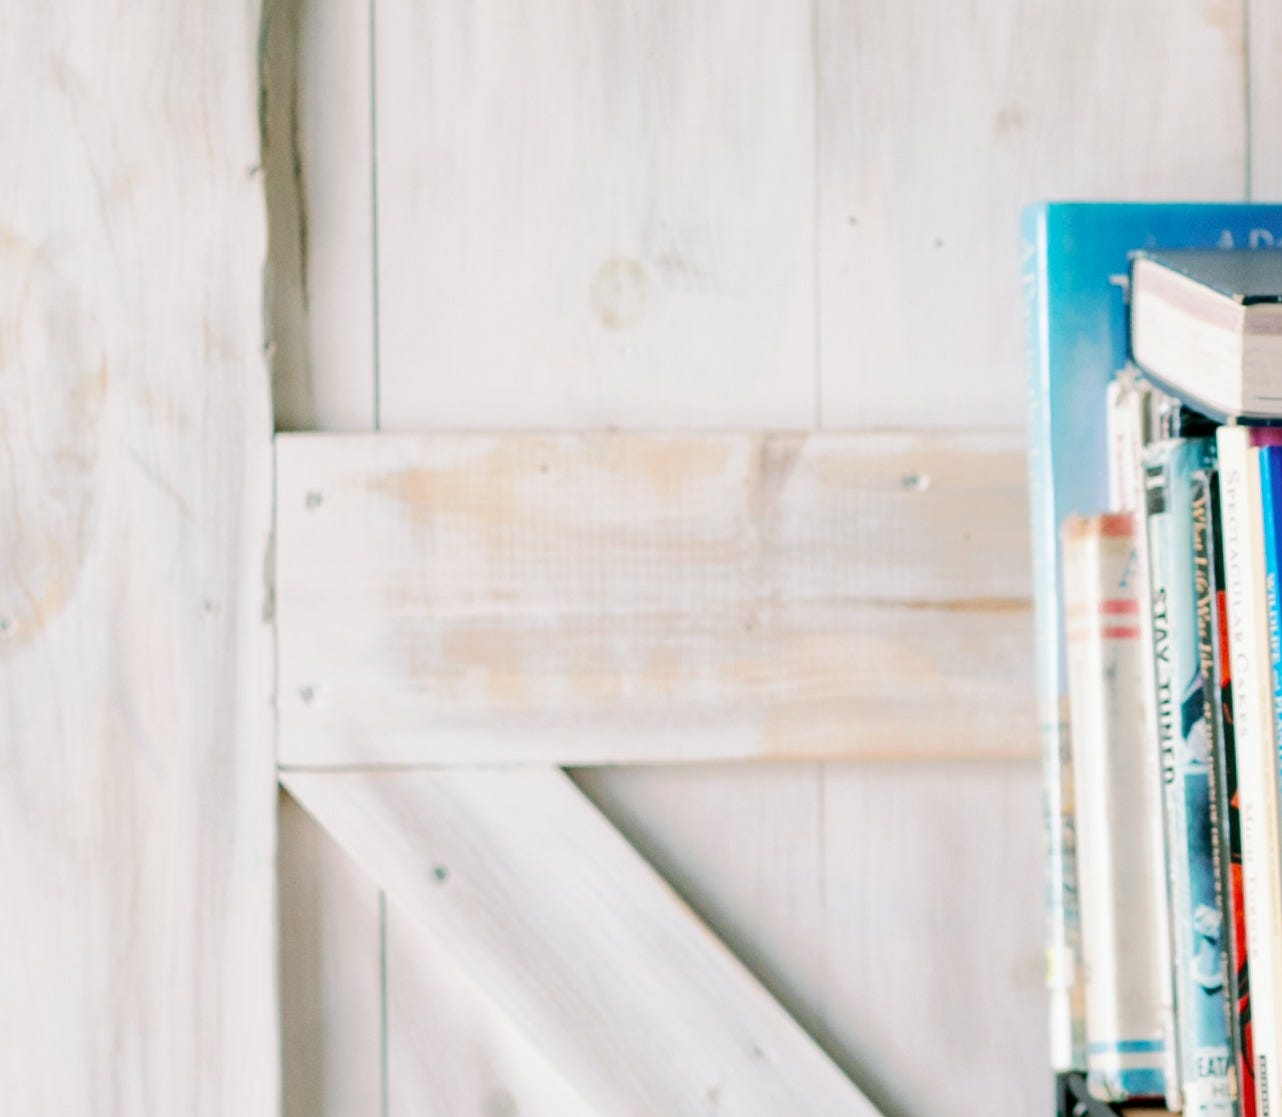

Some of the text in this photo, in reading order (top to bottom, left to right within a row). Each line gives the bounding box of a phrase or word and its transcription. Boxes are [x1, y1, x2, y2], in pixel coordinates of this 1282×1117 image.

[1152, 588, 1176, 784] STAY TUNED
[1267, 572, 1280, 661] WILDLIFE
